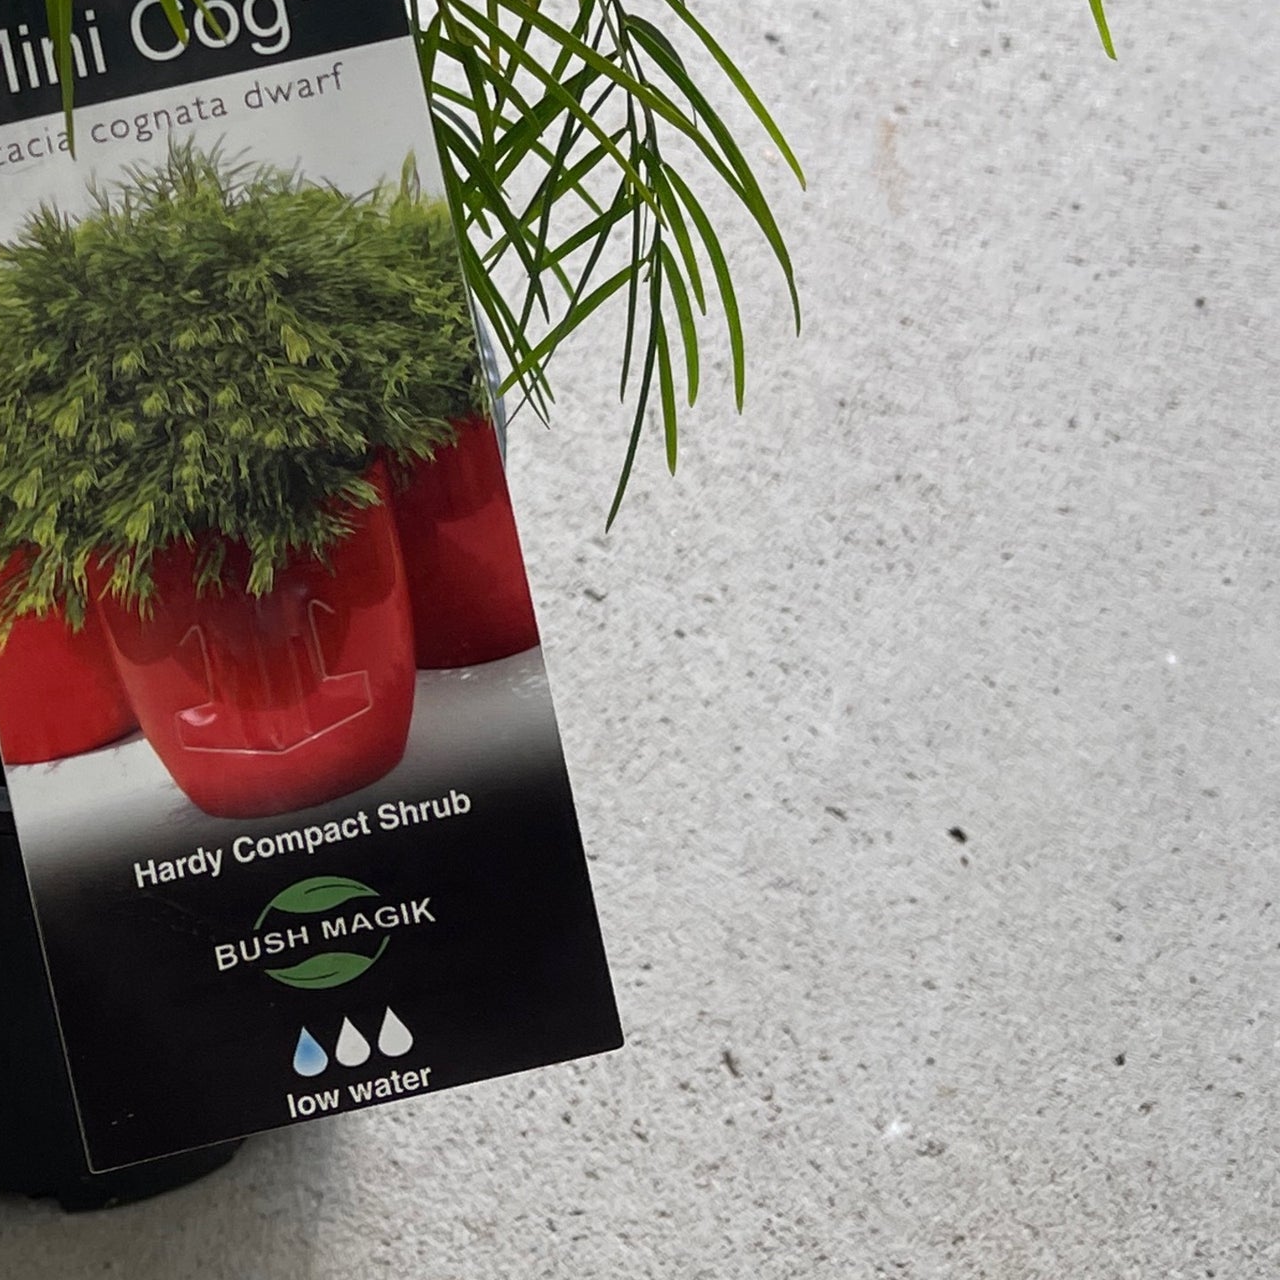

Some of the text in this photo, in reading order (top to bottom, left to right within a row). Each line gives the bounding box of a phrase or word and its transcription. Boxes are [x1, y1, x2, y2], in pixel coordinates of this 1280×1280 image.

[91, 96, 228, 143] cognata
[245, 62, 344, 110] dwarf
[134, 790, 472, 887] Hardy Compact Shrub
[215, 898, 436, 971] BUSH MAGIK
[288, 1065, 432, 1118] low water
